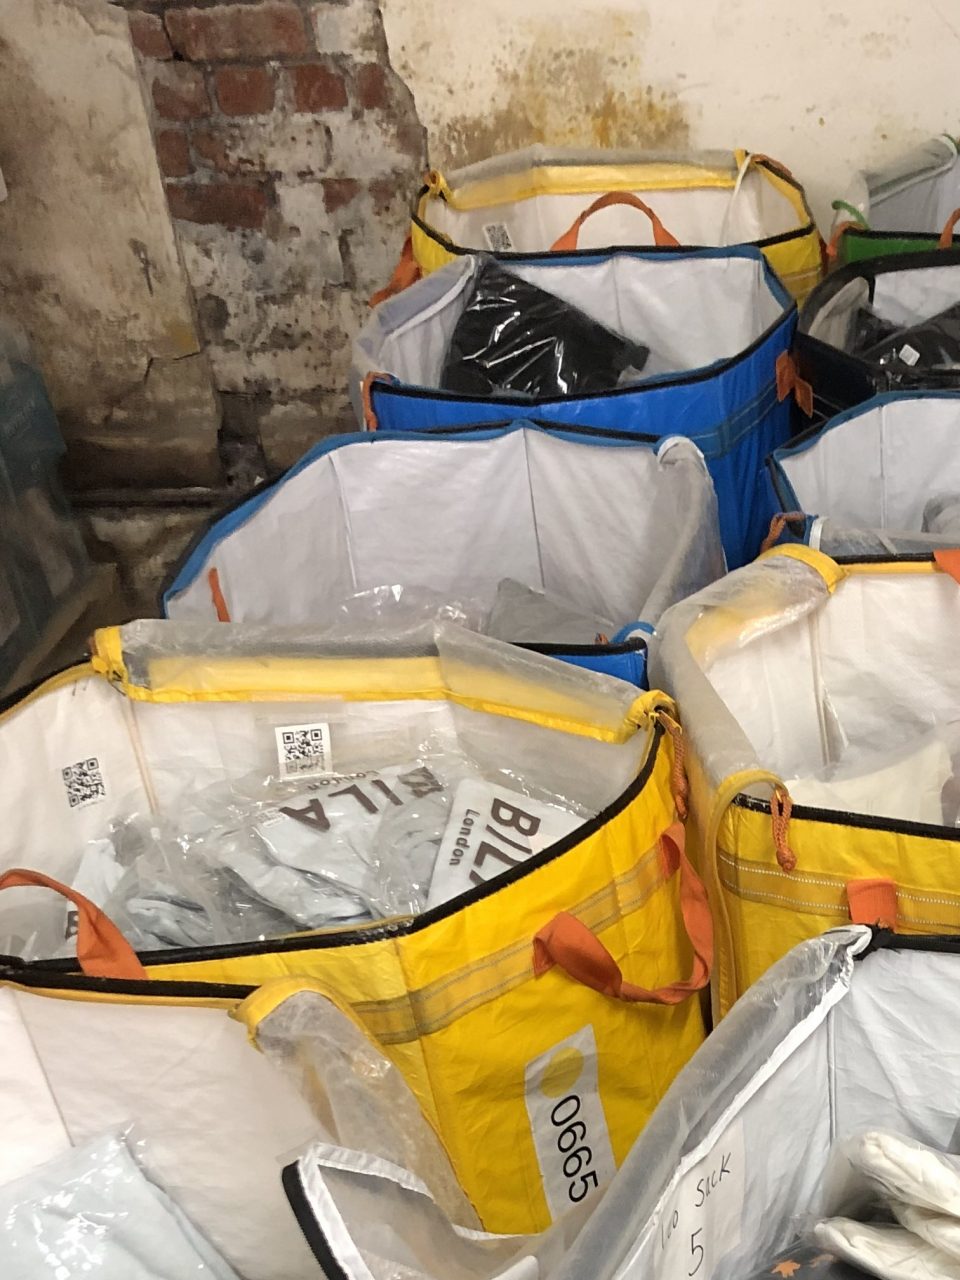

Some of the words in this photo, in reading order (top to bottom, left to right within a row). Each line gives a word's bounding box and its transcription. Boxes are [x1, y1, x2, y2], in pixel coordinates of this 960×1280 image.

[448, 808, 481, 866] London
[468, 797, 541, 886] BIL
[550, 1094, 599, 1203] 0665
